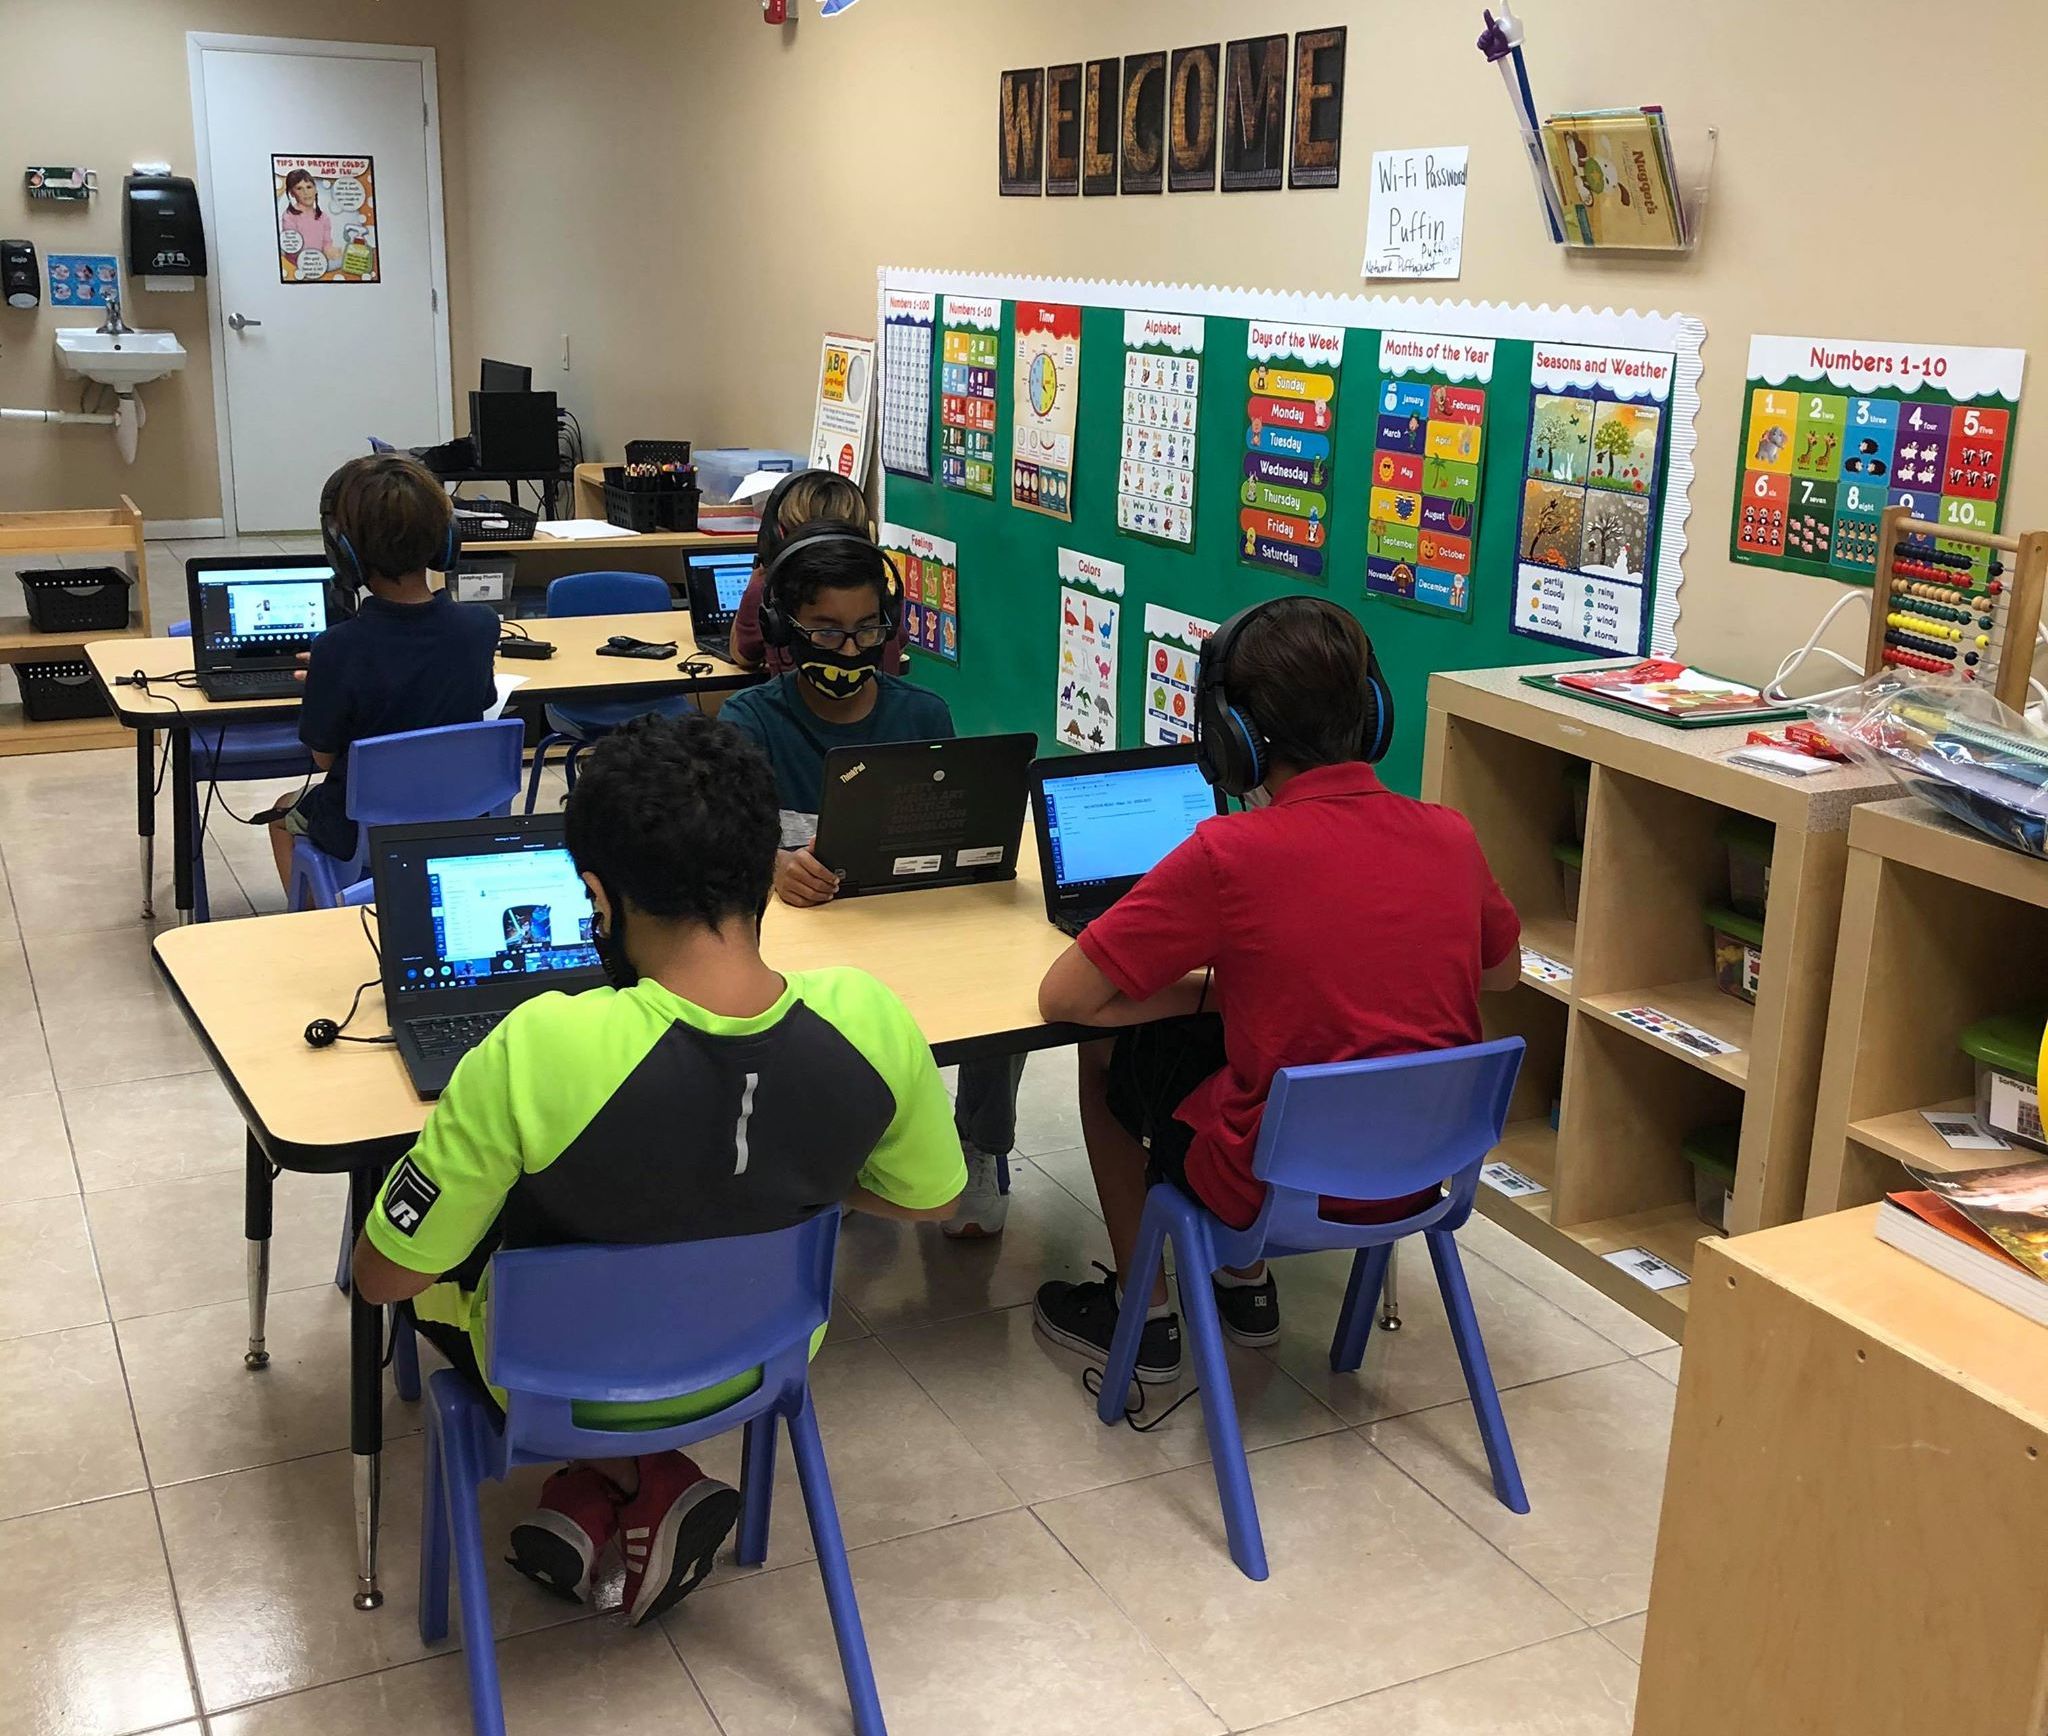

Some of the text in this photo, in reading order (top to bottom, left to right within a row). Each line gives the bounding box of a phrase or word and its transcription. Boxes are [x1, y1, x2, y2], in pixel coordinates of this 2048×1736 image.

[1001, 30, 1342, 180] WELCOME
[276, 159, 294, 167] TIPS
[307, 160, 339, 168] PREVENT
[342, 160, 366, 168] COLDS
[320, 167, 337, 175] AND
[1378, 154, 1468, 193] Wi-Fi Password
[1389, 207, 1444, 245] Puffin
[890, 297, 930, 311] Numbers 1-100
[949, 302, 992, 318] Numbers 1-10
[1038, 308, 1056, 324] Time
[1144, 321, 1181, 336] Alphabet
[1252, 328, 1339, 351] Days of the Week
[1385, 339, 1489, 364] Months of the Year
[827, 354, 847, 376] ABC
[1536, 351, 1668, 379] Seasons and Weather
[1810, 346, 1948, 377] Numbers 1-10
[1276, 376, 1306, 395] Sunday
[1402, 393, 1424, 407] January
[1452, 399, 1481, 414] February
[1764, 394, 1775, 413] 1
[1809, 397, 1822, 418] 2
[1271, 404, 1304, 423] Monday
[1634, 409, 1656, 419] Summer
[1856, 400, 1887, 425] 3 three
[1908, 406, 1938, 431] 4 four
[1963, 410, 1994, 436] 5 five
[1382, 427, 1401, 439] March
[1270, 432, 1302, 453] Tuesday
[1259, 460, 1309, 484] Wednesday
[1400, 466, 1414, 479] May
[1454, 475, 1469, 487] June
[1754, 474, 1769, 497] 6
[1801, 481, 1814, 504] 7
[1263, 488, 1301, 511] Thursday
[1847, 486, 1875, 513] 8 eight
[1424, 509, 1445, 522] August
[1911, 510, 1925, 519] nine
[1948, 502, 1986, 527] 10 ten
[1267, 518, 1294, 539] Friday
[911, 534, 933, 551] Feelings
[1382, 534, 1415, 550] September
[1262, 545, 1299, 567] Saturday
[1439, 546, 1466, 561] October
[1078, 559, 1101, 577] Colors
[1368, 568, 1396, 582] November
[1418, 578, 1451, 594] December
[1543, 576, 1564, 589] partly
[1543, 588, 1565, 601] cloudy
[1598, 586, 1615, 599] rainy
[1541, 602, 1560, 614] sunny
[1597, 601, 1619, 614] snowy
[1188, 621, 1215, 640] Shape
[1540, 617, 1562, 629] cloudy
[1596, 616, 1617, 628] windy
[1594, 629, 1618, 644] stormy
[839, 761, 867, 784] ThinkPad
[1999, 1076, 2038, 1096] Sorting Tra
